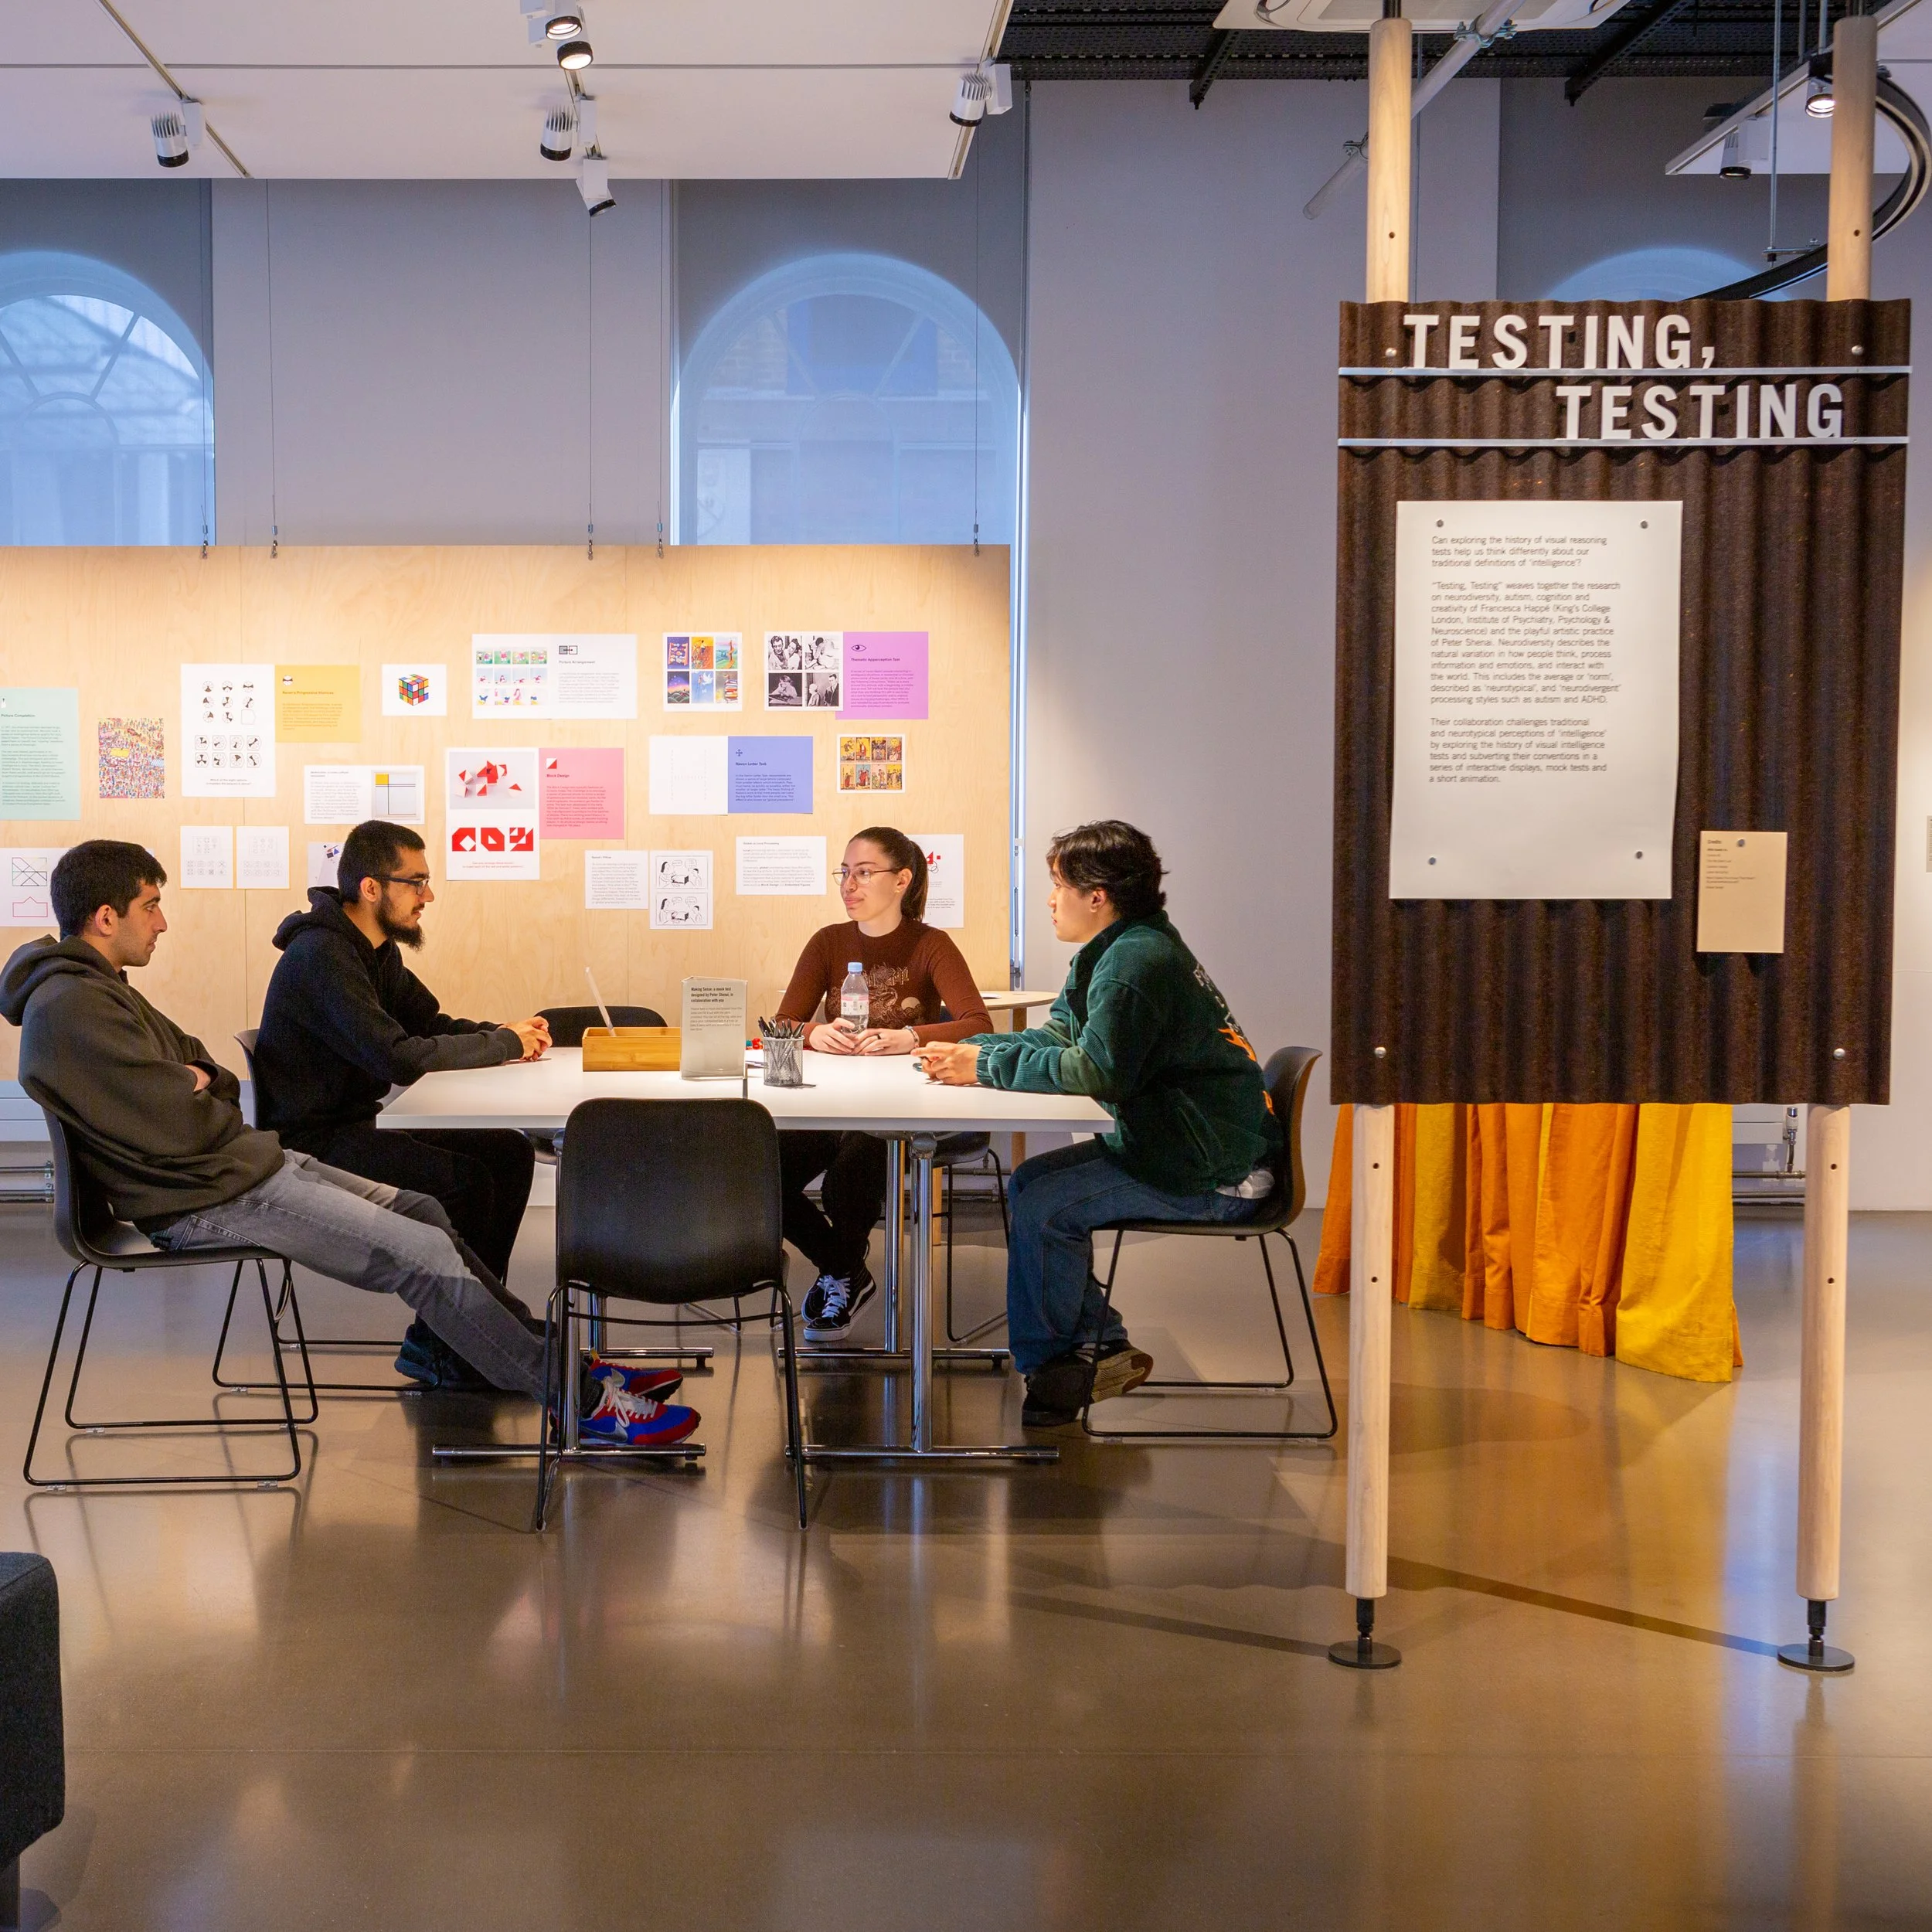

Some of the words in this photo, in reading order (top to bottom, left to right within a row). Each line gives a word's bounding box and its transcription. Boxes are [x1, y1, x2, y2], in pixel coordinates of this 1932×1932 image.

[1403, 315, 1716, 369] TESTING,
[1556, 383, 1843, 440] TESTING
[1432, 536, 1447, 544] Can
[1451, 536, 1487, 546] exploring
[1489, 536, 1502, 544] the
[1505, 536, 1532, 546] history
[1534, 536, 1542, 544] of
[1545, 536, 1567, 544] visual
[1570, 536, 1607, 546] reasoning
[1432, 547, 1452, 556] tests
[1454, 547, 1471, 557] help
[1486, 547, 1506, 556] think
[1509, 547, 1549, 557] differently
[1552, 547, 1573, 556] about
[1432, 559, 1471, 567] traditional
[1475, 559, 1515, 567] definitions
[1518, 559, 1526, 567] of
[1537, 581, 1570, 591] together
[1572, 581, 1585, 590] the
[1587, 581, 1620, 590] research
[1536, 593, 1573, 603] cognition
[1575, 593, 1590, 601] and
[1431, 604, 1468, 614] creativity
[1470, 604, 1478, 613] of
[1481, 604, 1521, 613] Francesca
[1582, 604, 1611, 614] College
[1467, 616, 1499, 624] Institute
[1502, 616, 1510, 624] of
[1558, 616, 1601, 626] Psychology
[1604, 616, 1611, 624] &
[1490, 627, 1505, 635] and
[1508, 627, 1521, 635] the
[1524, 627, 1550, 637] playful
[1553, 627, 1580, 635] artistic
[1583, 627, 1614, 637] practice
[1430, 638, 1439, 647] of
[1441, 638, 1463, 647] Peter
[1498, 638, 1555, 648] Neurodiversity
[1556, 638, 1595, 647] describes
[1597, 638, 1611, 647] the
[1431, 650, 1458, 658] natural
[1462, 650, 1495, 658] variation
[1498, 650, 1505, 658] in
[1509, 650, 1525, 658] how
[1527, 650, 1553, 660] people
[1431, 661, 1476, 669] information
[1478, 661, 1494, 669] and
[1537, 661, 1553, 669] and
[1556, 661, 1585, 669] interact
[1588, 661, 1604, 669] with
[1430, 672, 1444, 681] the
[1473, 672, 1490, 681] This
[1493, 672, 1526, 681] includes
[1528, 672, 1542, 681] the
[1430, 684, 1469, 692] described
[1541, 684, 1556, 692] and
[1431, 695, 1473, 705] processing
[1475, 695, 1499, 705] styles
[1501, 695, 1520, 703] such
[1534, 695, 1561, 703] autism
[1563, 695, 1578, 703] and
[1430, 718, 1451, 726] Their
[1453, 718, 1503, 726] collaboration
[1506, 718, 1548, 728] challenges
[1550, 718, 1590, 726] traditional
[1430, 729, 1445, 737] and
[1448, 729, 1496, 739] neurotypical
[1499, 729, 1545, 739] perceptions
[1547, 729, 1555, 737] of
[1430, 740, 1440, 750] by
[1442, 740, 1478, 750] exploring
[1480, 740, 1493, 749] the
[1495, 740, 1522, 750] history
[1524, 740, 1533, 749] of
[1536, 740, 1558, 749] visual
[1561, 740, 1605, 750] intelligence
[1430, 752, 1450, 760] tests
[1451, 752, 1467, 760] and
[1469, 752, 1510, 762] subverting
[1512, 752, 1531, 760] their
[1532, 752, 1580, 760] conventions
[1582, 752, 1590, 760] in
[1429, 763, 1453, 771] series
[1455, 763, 1464, 771] of
[1466, 763, 1506, 771] interactive
[1546, 763, 1567, 771] mock
[1570, 763, 1590, 771] tests
[1592, 763, 1607, 771] and
[1437, 774, 1458, 783] short
